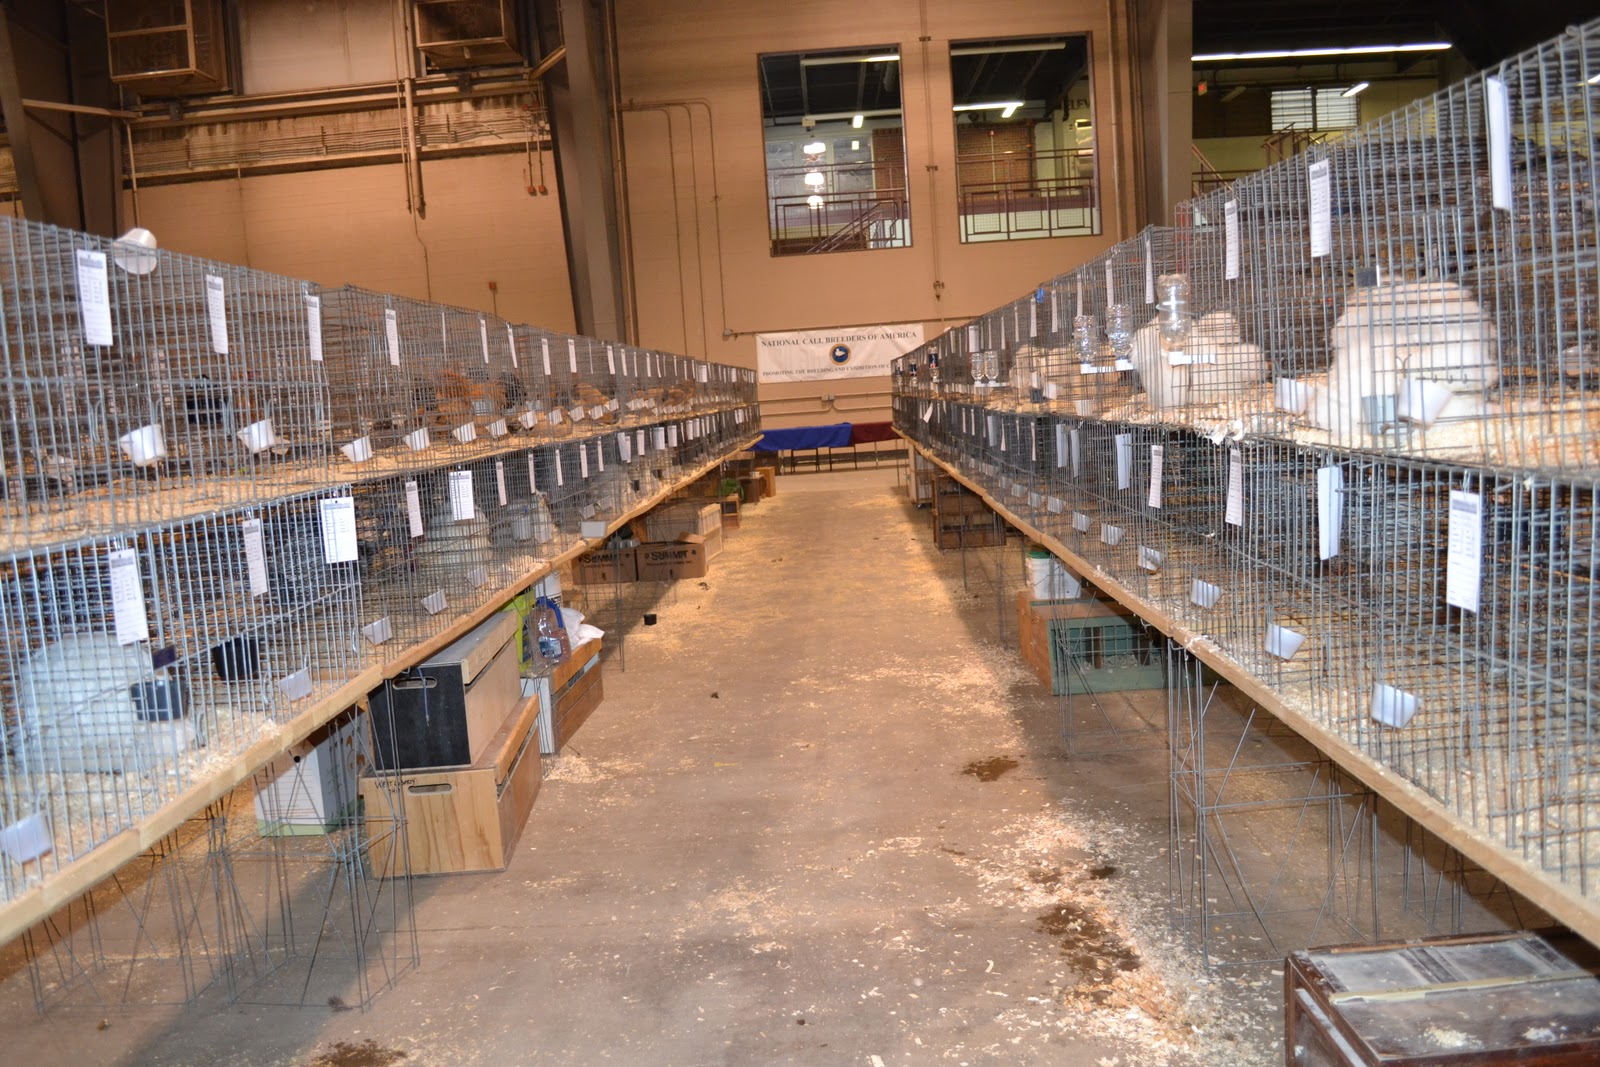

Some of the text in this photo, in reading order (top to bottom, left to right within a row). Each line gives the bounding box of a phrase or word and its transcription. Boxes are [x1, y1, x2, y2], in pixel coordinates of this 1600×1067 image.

[761, 339, 801, 347] NATIONAL
[802, 337, 823, 345] CALL
[825, 335, 867, 343] BREEDERS
[880, 331, 917, 340] AMERICA
[651, 550, 689, 561] SUMMIT
